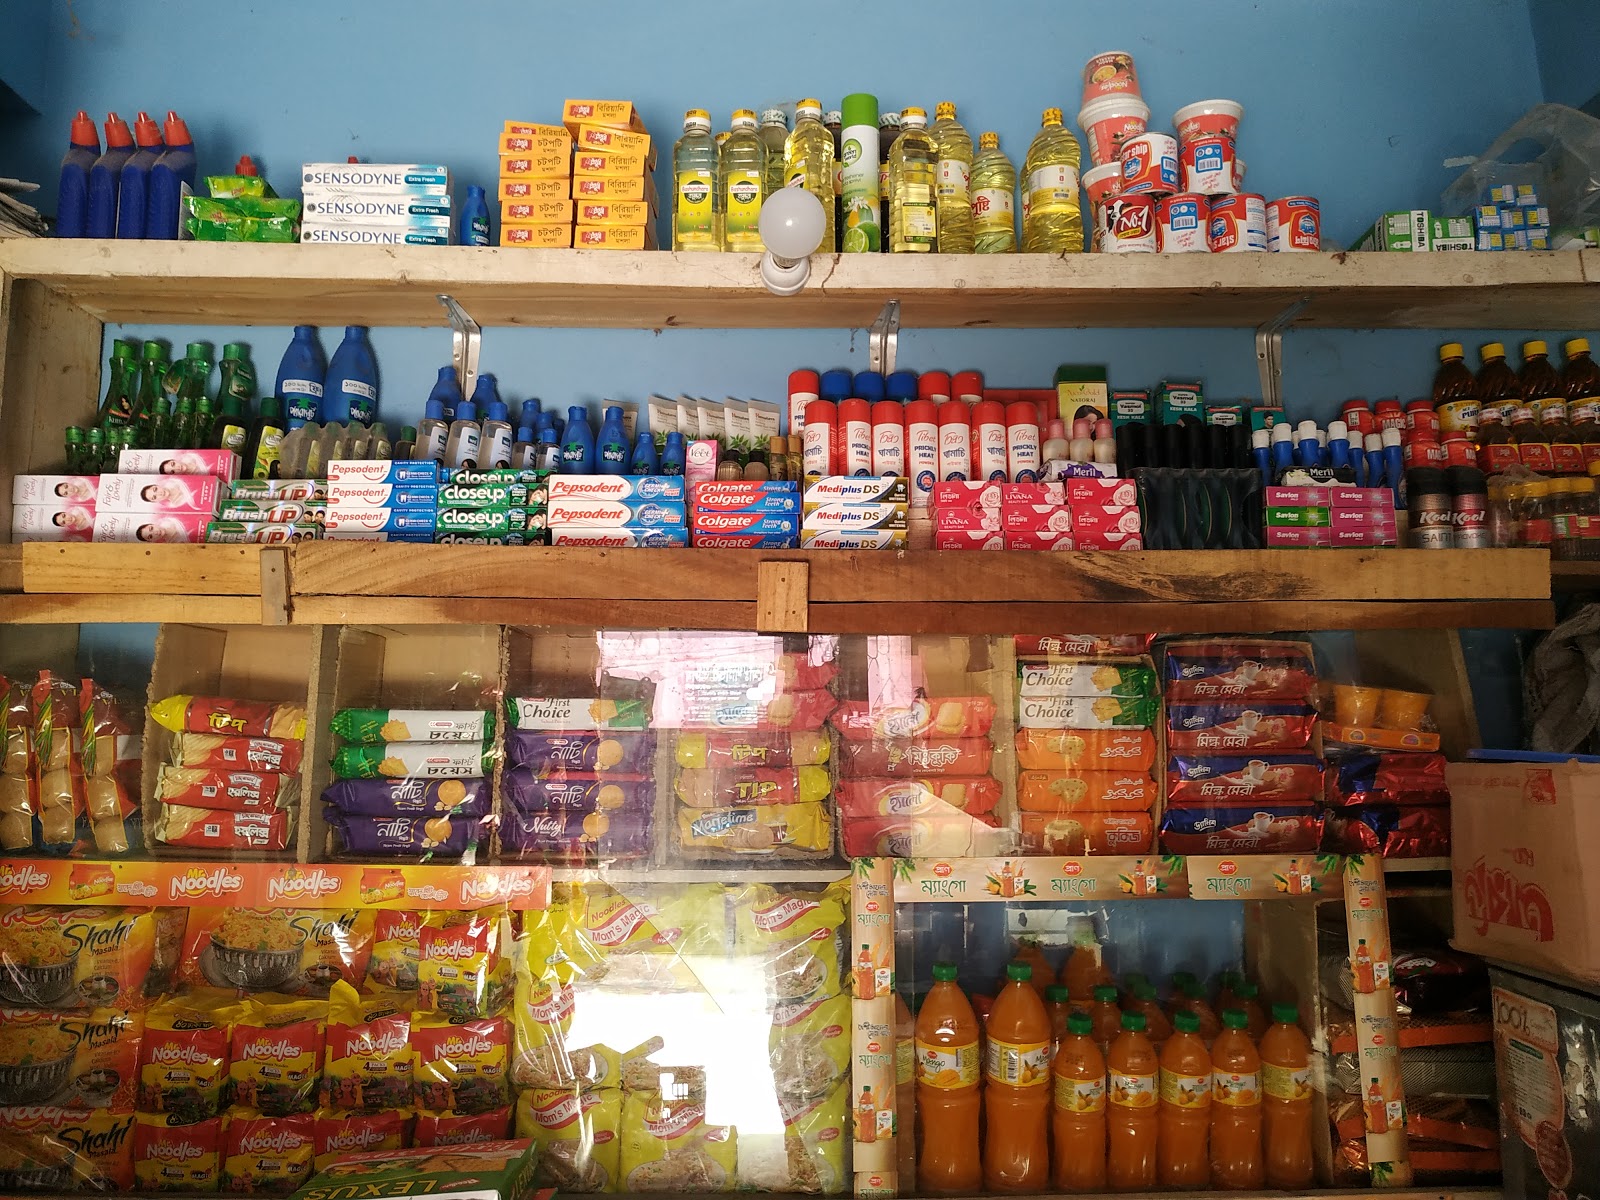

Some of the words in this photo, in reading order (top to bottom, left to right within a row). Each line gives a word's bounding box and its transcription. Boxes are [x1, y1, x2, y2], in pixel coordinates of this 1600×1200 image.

[314, 172, 402, 185] SENSODYNE
[317, 202, 404, 215] SENSODYNE
[312, 230, 400, 244] SENSODYNE
[1417, 212, 1425, 248] TOSHIBA
[1436, 243, 1473, 251] TOSHIBA
[1382, 419, 1406, 429] MAGIC
[916, 430, 936, 441] Tibet
[1014, 430, 1035, 442] Tibet
[691, 448, 710, 457] Veet
[332, 464, 384, 475] Pepsodent
[1073, 466, 1096, 477] Meril
[1310, 468, 1334, 477] Meril
[30, 478, 39, 496] Lovely
[111, 477, 124, 502] Lovely
[333, 488, 385, 499] Pepsodent
[552, 482, 624, 495] Pepsodent
[817, 485, 862, 496] Mediplus
[863, 485, 879, 494] DS
[102, 492, 110, 507] Fair
[444, 486, 504, 504] closeup
[700, 494, 754, 506] Colgate
[330, 511, 383, 522] Pepsodent
[443, 510, 504, 529] closeup
[551, 508, 624, 521] Pepsodent
[816, 512, 861, 522] Mediplus
[862, 512, 879, 520] DS
[1420, 511, 1450, 524] Kool
[1452, 510, 1485, 525] Kool
[109, 516, 120, 541] Lovely
[698, 516, 753, 528] Colgate
[555, 536, 628, 546] Pepsodent
[697, 537, 751, 549] Colgate
[814, 539, 859, 549] Mediplus
[860, 540, 877, 549] DS
[1038, 637, 1061, 653] মিল্ক
[1065, 637, 1092, 653] মেরী
[1050, 666, 1073, 676] First
[1025, 672, 1073, 686] Choice
[1194, 682, 1218, 695] মিল্ক
[1220, 684, 1248, 695] মেরী
[1050, 697, 1073, 706] First
[524, 704, 571, 718] Choice
[1025, 704, 1074, 718] Choice
[208, 713, 247, 732] টিপ
[1197, 733, 1220, 747] মিল্ক
[1223, 733, 1249, 747] মেরী
[551, 741, 584, 760] নাটি
[731, 744, 768, 760] টিপ
[427, 767, 475, 775] চয়েস
[552, 786, 584, 804] নাটি
[736, 781, 777, 798] TIP
[1200, 783, 1225, 796] মিল্ক
[1227, 783, 1255, 796] মেরী
[377, 818, 410, 836] নাটি
[524, 817, 563, 837] Nutty
[1105, 827, 1141, 847] কুকিজ
[1206, 836, 1230, 849] মিল্ক
[1232, 836, 1261, 848] মেরী
[187, 868, 204, 879] Mr.
[171, 869, 242, 899] Noodles
[268, 869, 340, 900] Noodles
[921, 880, 967, 897] ম্যাংগো
[1051, 878, 1096, 897] ম্যাংগো
[1207, 877, 1252, 895] ম্যাংগো
[591, 898, 626, 923] Noodles
[592, 921, 624, 942] Mom's
[622, 905, 650, 926] Magic
[754, 910, 784, 926] Mom's
[857, 914, 890, 926] ম্যাংগো
[63, 916, 138, 958] Shahi
[434, 939, 447, 947] Mr.
[92, 946, 120, 956] Masala
[425, 943, 474, 960] Noodles
[60, 1010, 128, 1051] Shahi
[90, 1038, 118, 1049] Masala
[165, 1042, 179, 1051] Mr.
[257, 1037, 271, 1046] Mr.
[347, 1032, 406, 1056] Noodles
[435, 1037, 492, 1057] Noodles
[447, 1037, 460, 1045] Mr.
[152, 1044, 209, 1064] Noodles
[244, 1040, 301, 1060] Noodles
[922, 1055, 945, 1072] Mango
[535, 1104, 564, 1125] Mom's
[58, 1116, 134, 1154] Shahi
[256, 1131, 270, 1140] Mr.
[327, 1130, 385, 1150] Noodles
[159, 1139, 173, 1148] Mr.
[241, 1132, 301, 1153] Noodles
[147, 1143, 203, 1160] Noodles
[305, 1178, 438, 1200] LEXUS
